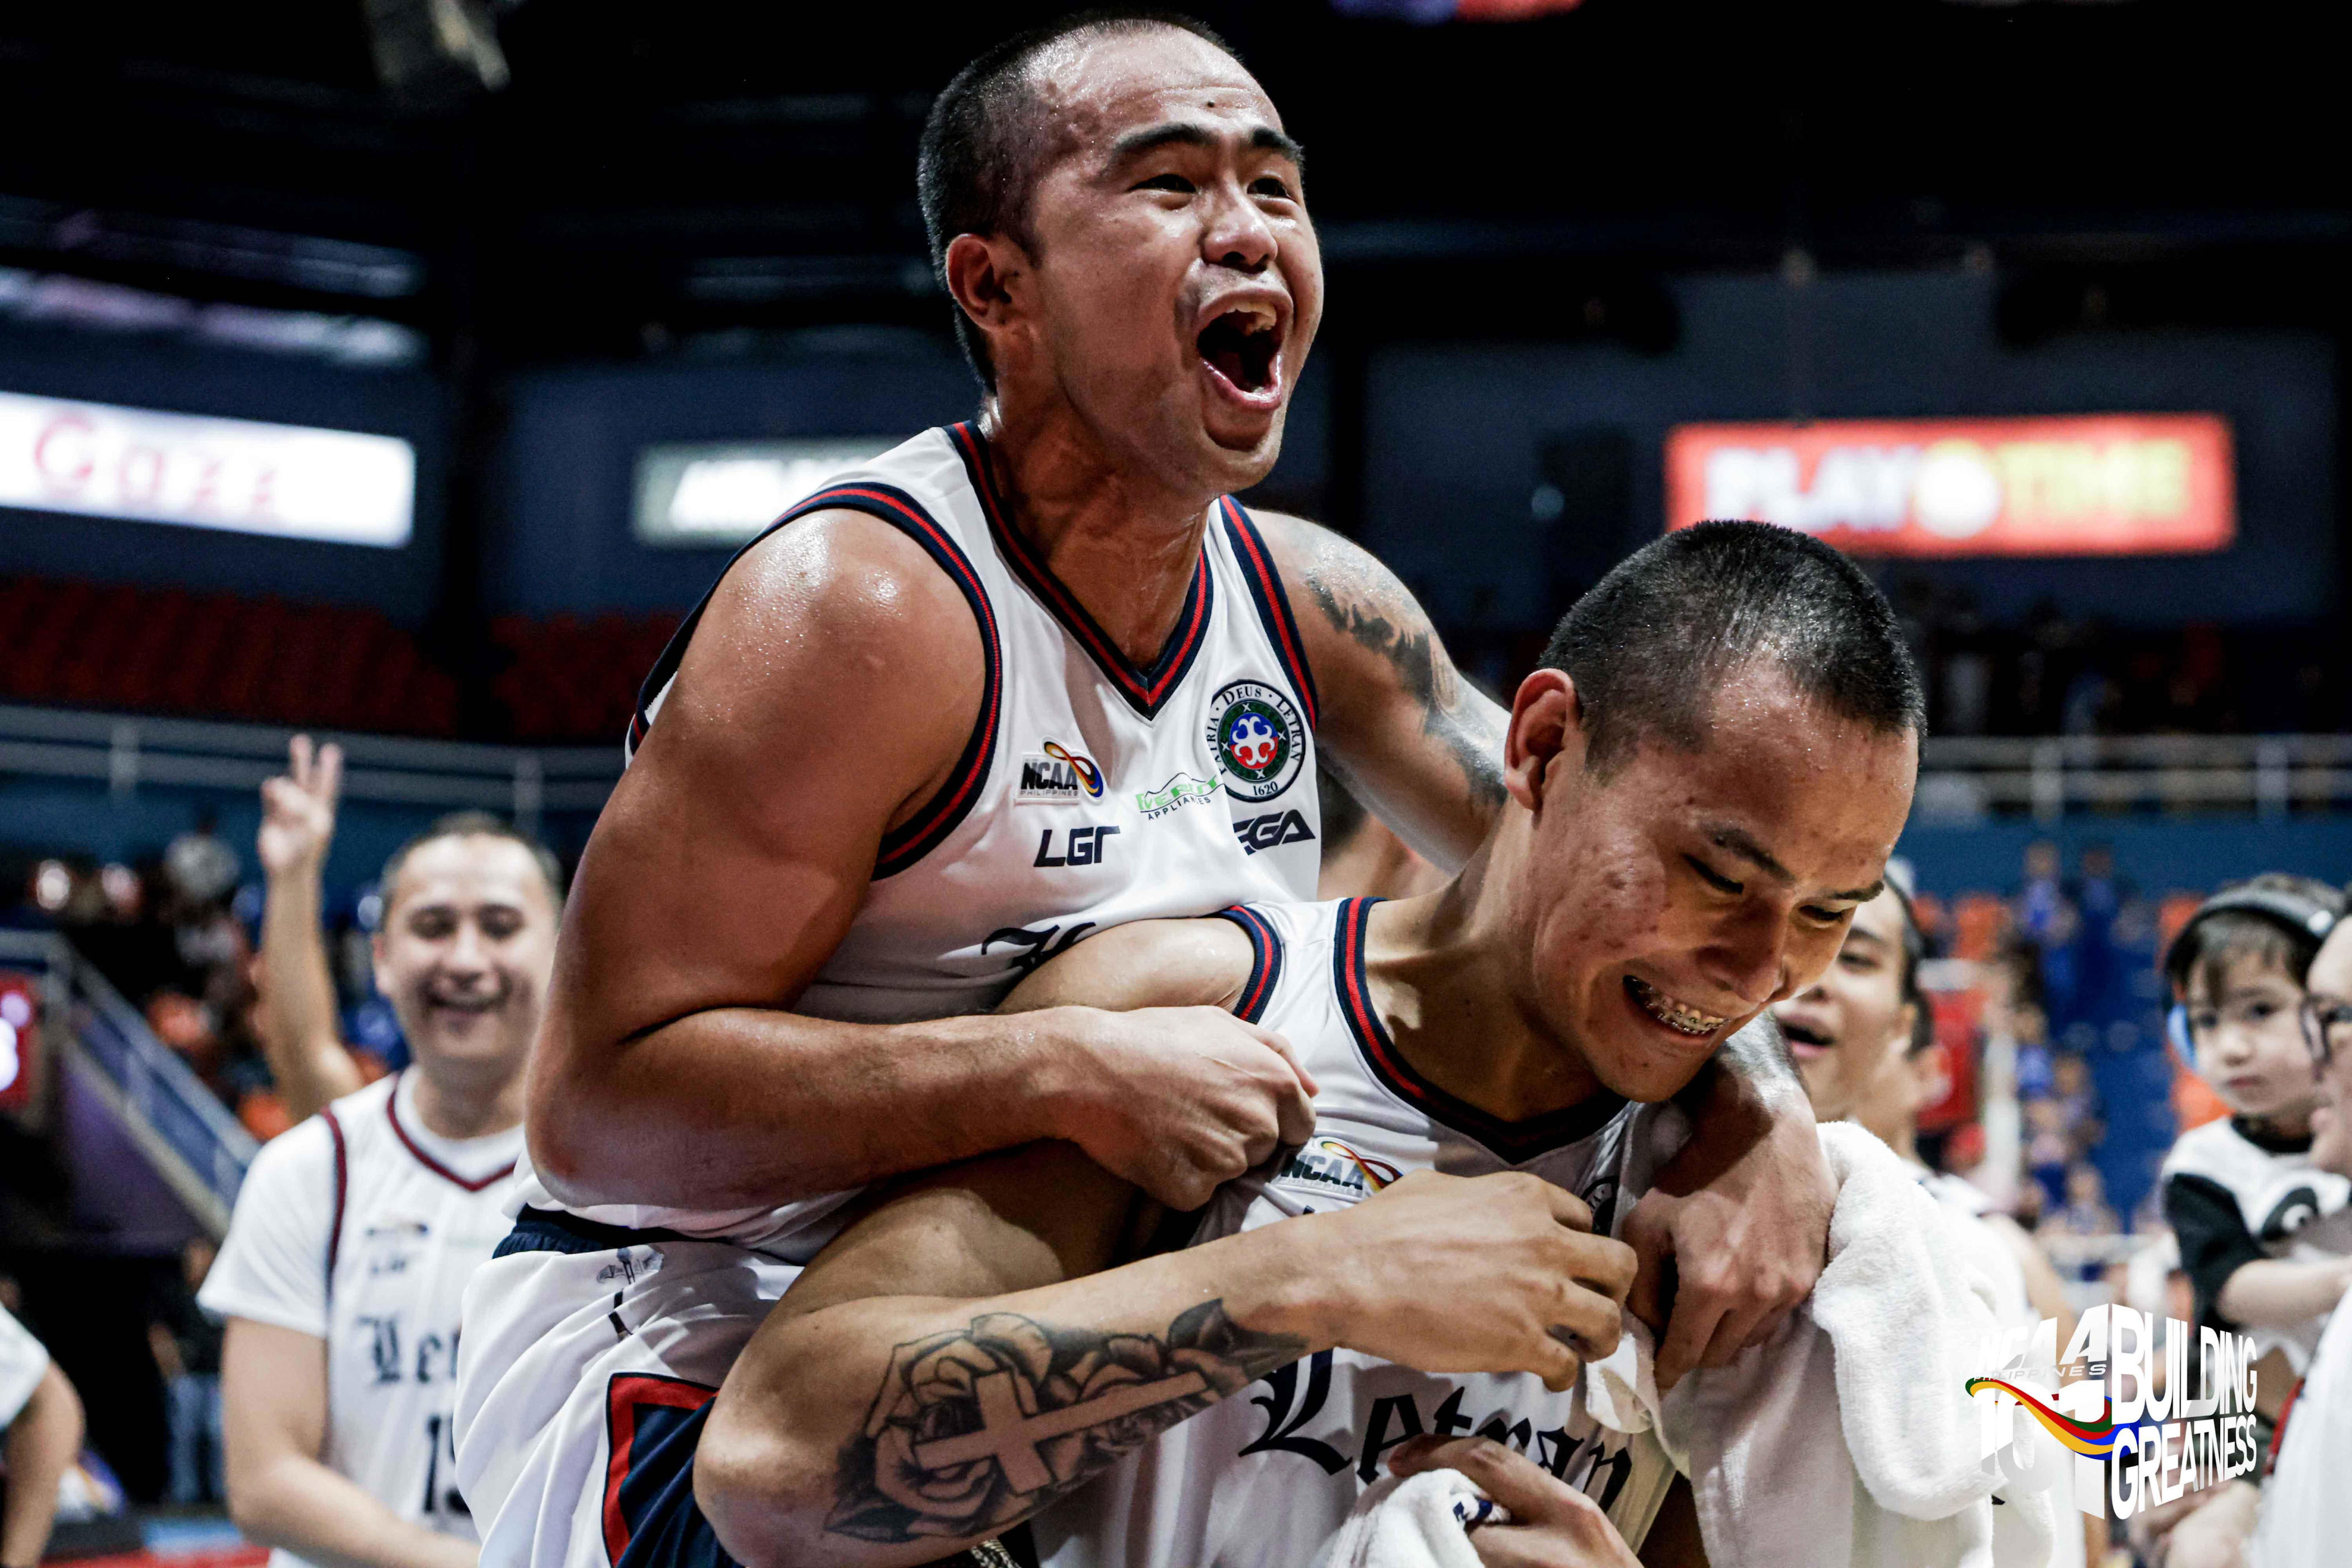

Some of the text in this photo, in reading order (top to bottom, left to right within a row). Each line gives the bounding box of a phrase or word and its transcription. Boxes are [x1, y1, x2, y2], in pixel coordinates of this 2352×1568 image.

[1207, 686, 1303, 774] TRIA DEUS LETRAN
[1021, 762, 1078, 790] NCAA
[1253, 781, 1279, 796] 1620
[1280, 1154, 1364, 1191] NCAA
